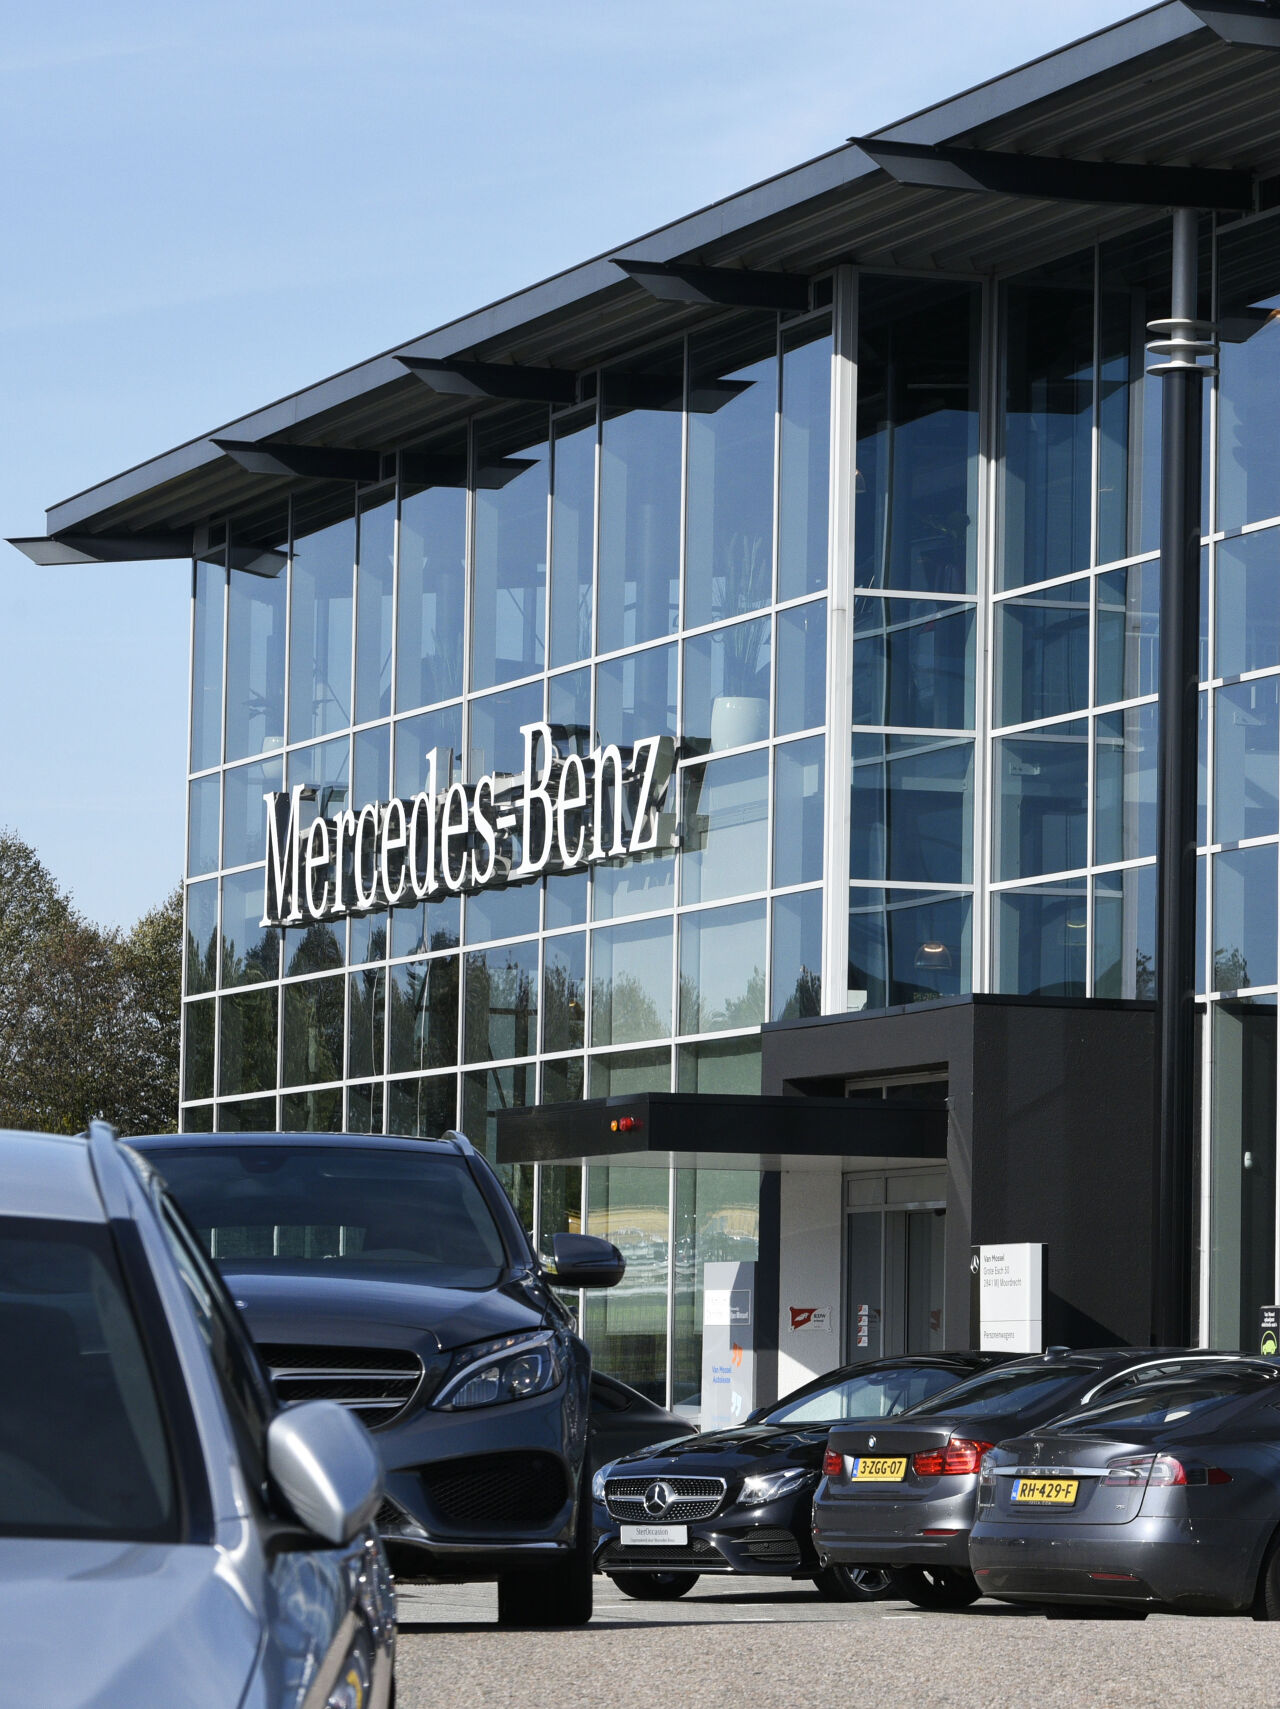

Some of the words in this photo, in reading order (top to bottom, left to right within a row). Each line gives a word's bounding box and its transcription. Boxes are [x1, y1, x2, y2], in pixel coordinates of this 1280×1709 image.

[259, 721, 662, 928] Mercedes-Benz
[860, 1460, 903, 1475] 3-ZGG-07
[1019, 1482, 1074, 1499] RH-429-F
